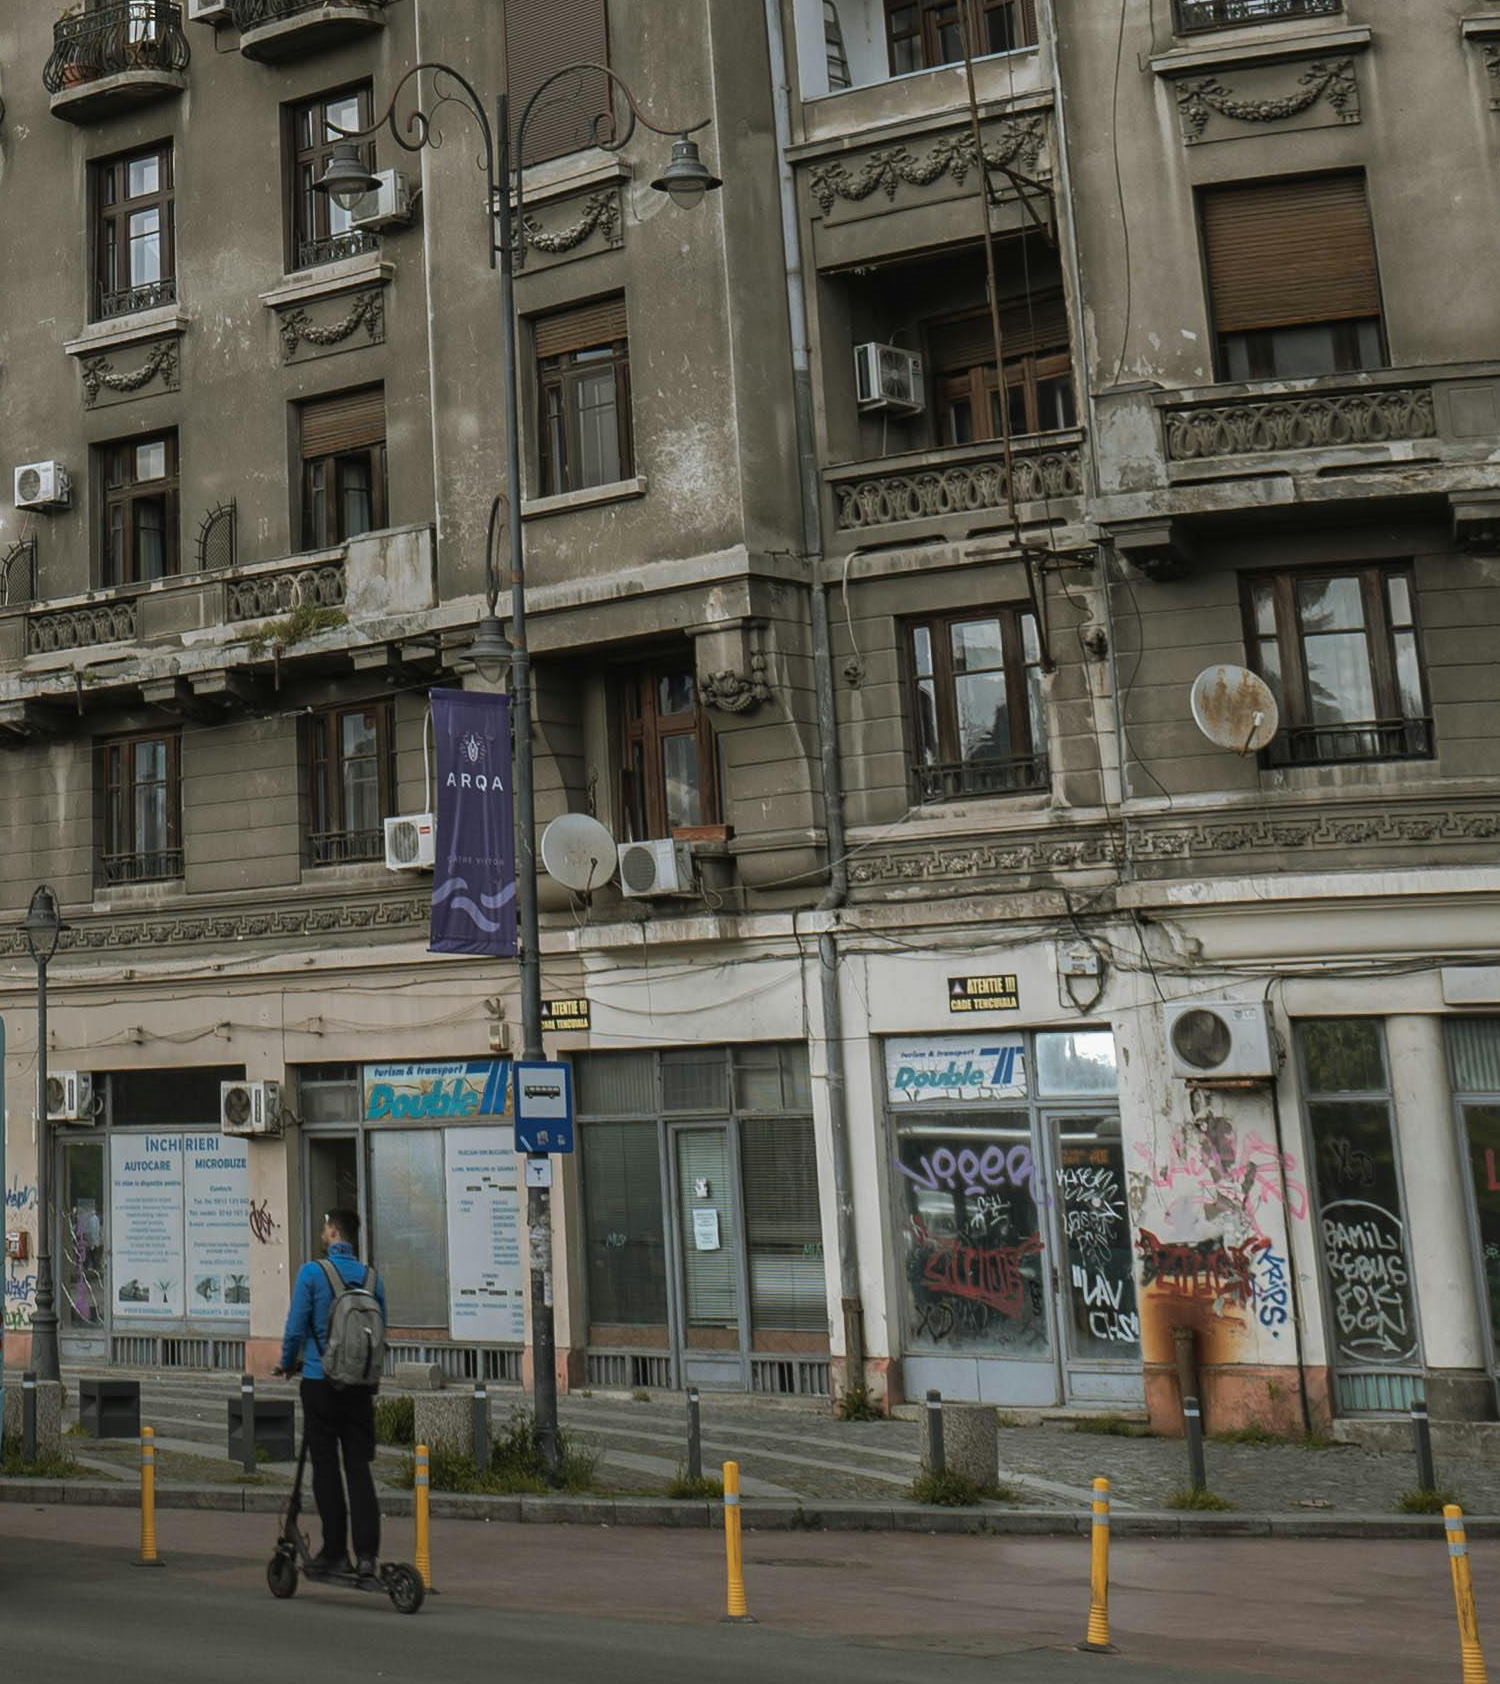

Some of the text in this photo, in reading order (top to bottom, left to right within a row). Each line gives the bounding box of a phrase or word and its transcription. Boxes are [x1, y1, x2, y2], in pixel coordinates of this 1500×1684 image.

[446, 772, 504, 791] ARQA
[374, 1067, 404, 1078] turism
[417, 1064, 464, 1079] transport
[895, 1061, 984, 1090] Double
[367, 1077, 480, 1120] Double
[124, 1158, 247, 1172] AUTOCARE MICROBUZE
